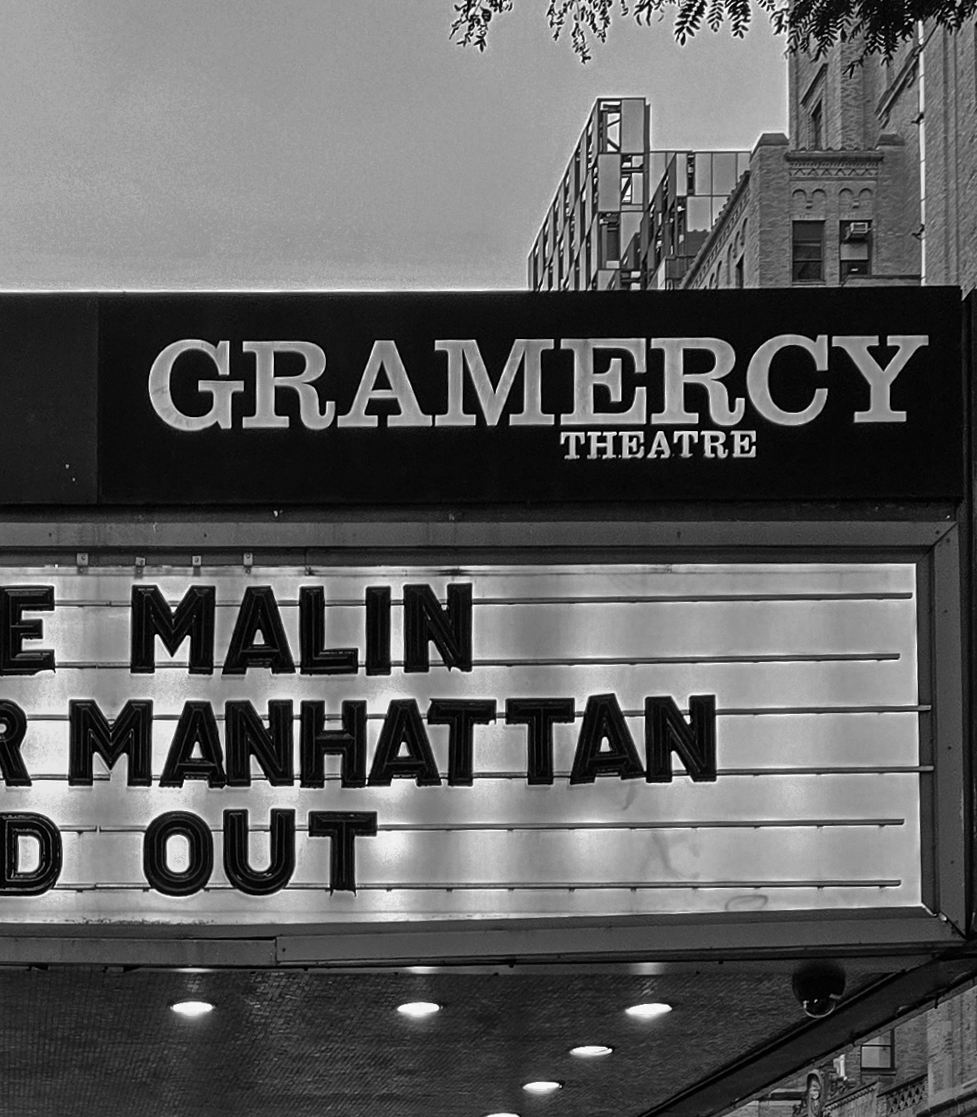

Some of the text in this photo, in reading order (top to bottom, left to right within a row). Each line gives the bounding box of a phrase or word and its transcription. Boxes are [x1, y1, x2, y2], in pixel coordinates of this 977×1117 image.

[147, 334, 930, 431] GRAMERCY
[559, 430, 758, 461] THEATRE
[130, 582, 474, 676] MALIN
[68, 692, 718, 789] MANHATTAN
[143, 808, 378, 898] OUT
